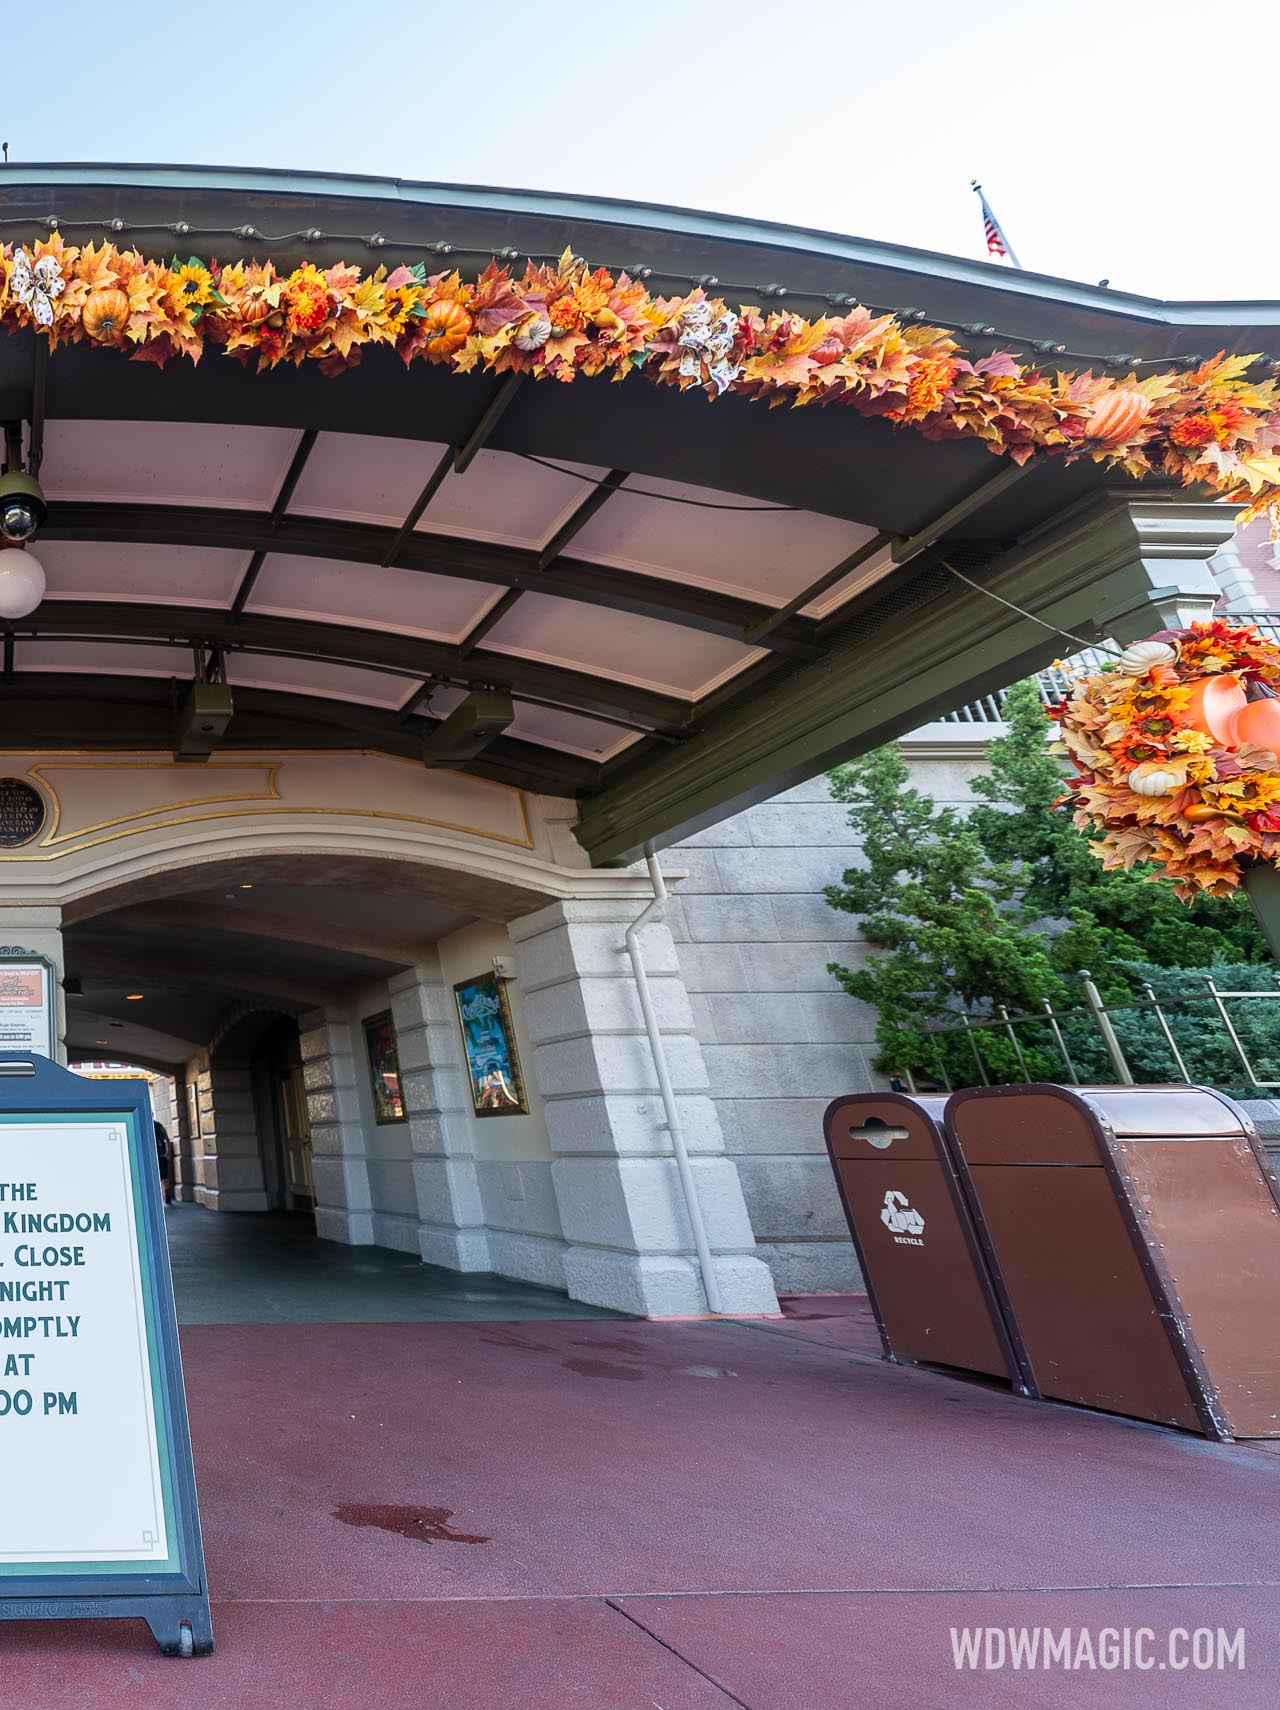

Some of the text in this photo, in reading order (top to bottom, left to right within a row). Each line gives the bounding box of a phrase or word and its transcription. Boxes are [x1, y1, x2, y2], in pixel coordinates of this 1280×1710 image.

[3, 1211, 111, 1233] KINGDOM
[893, 1236, 925, 1246] RECYCLE
[14, 1244, 85, 1267] CLOSE
[4, 1354, 35, 1376] AT
[43, 1391, 78, 1415] PM
